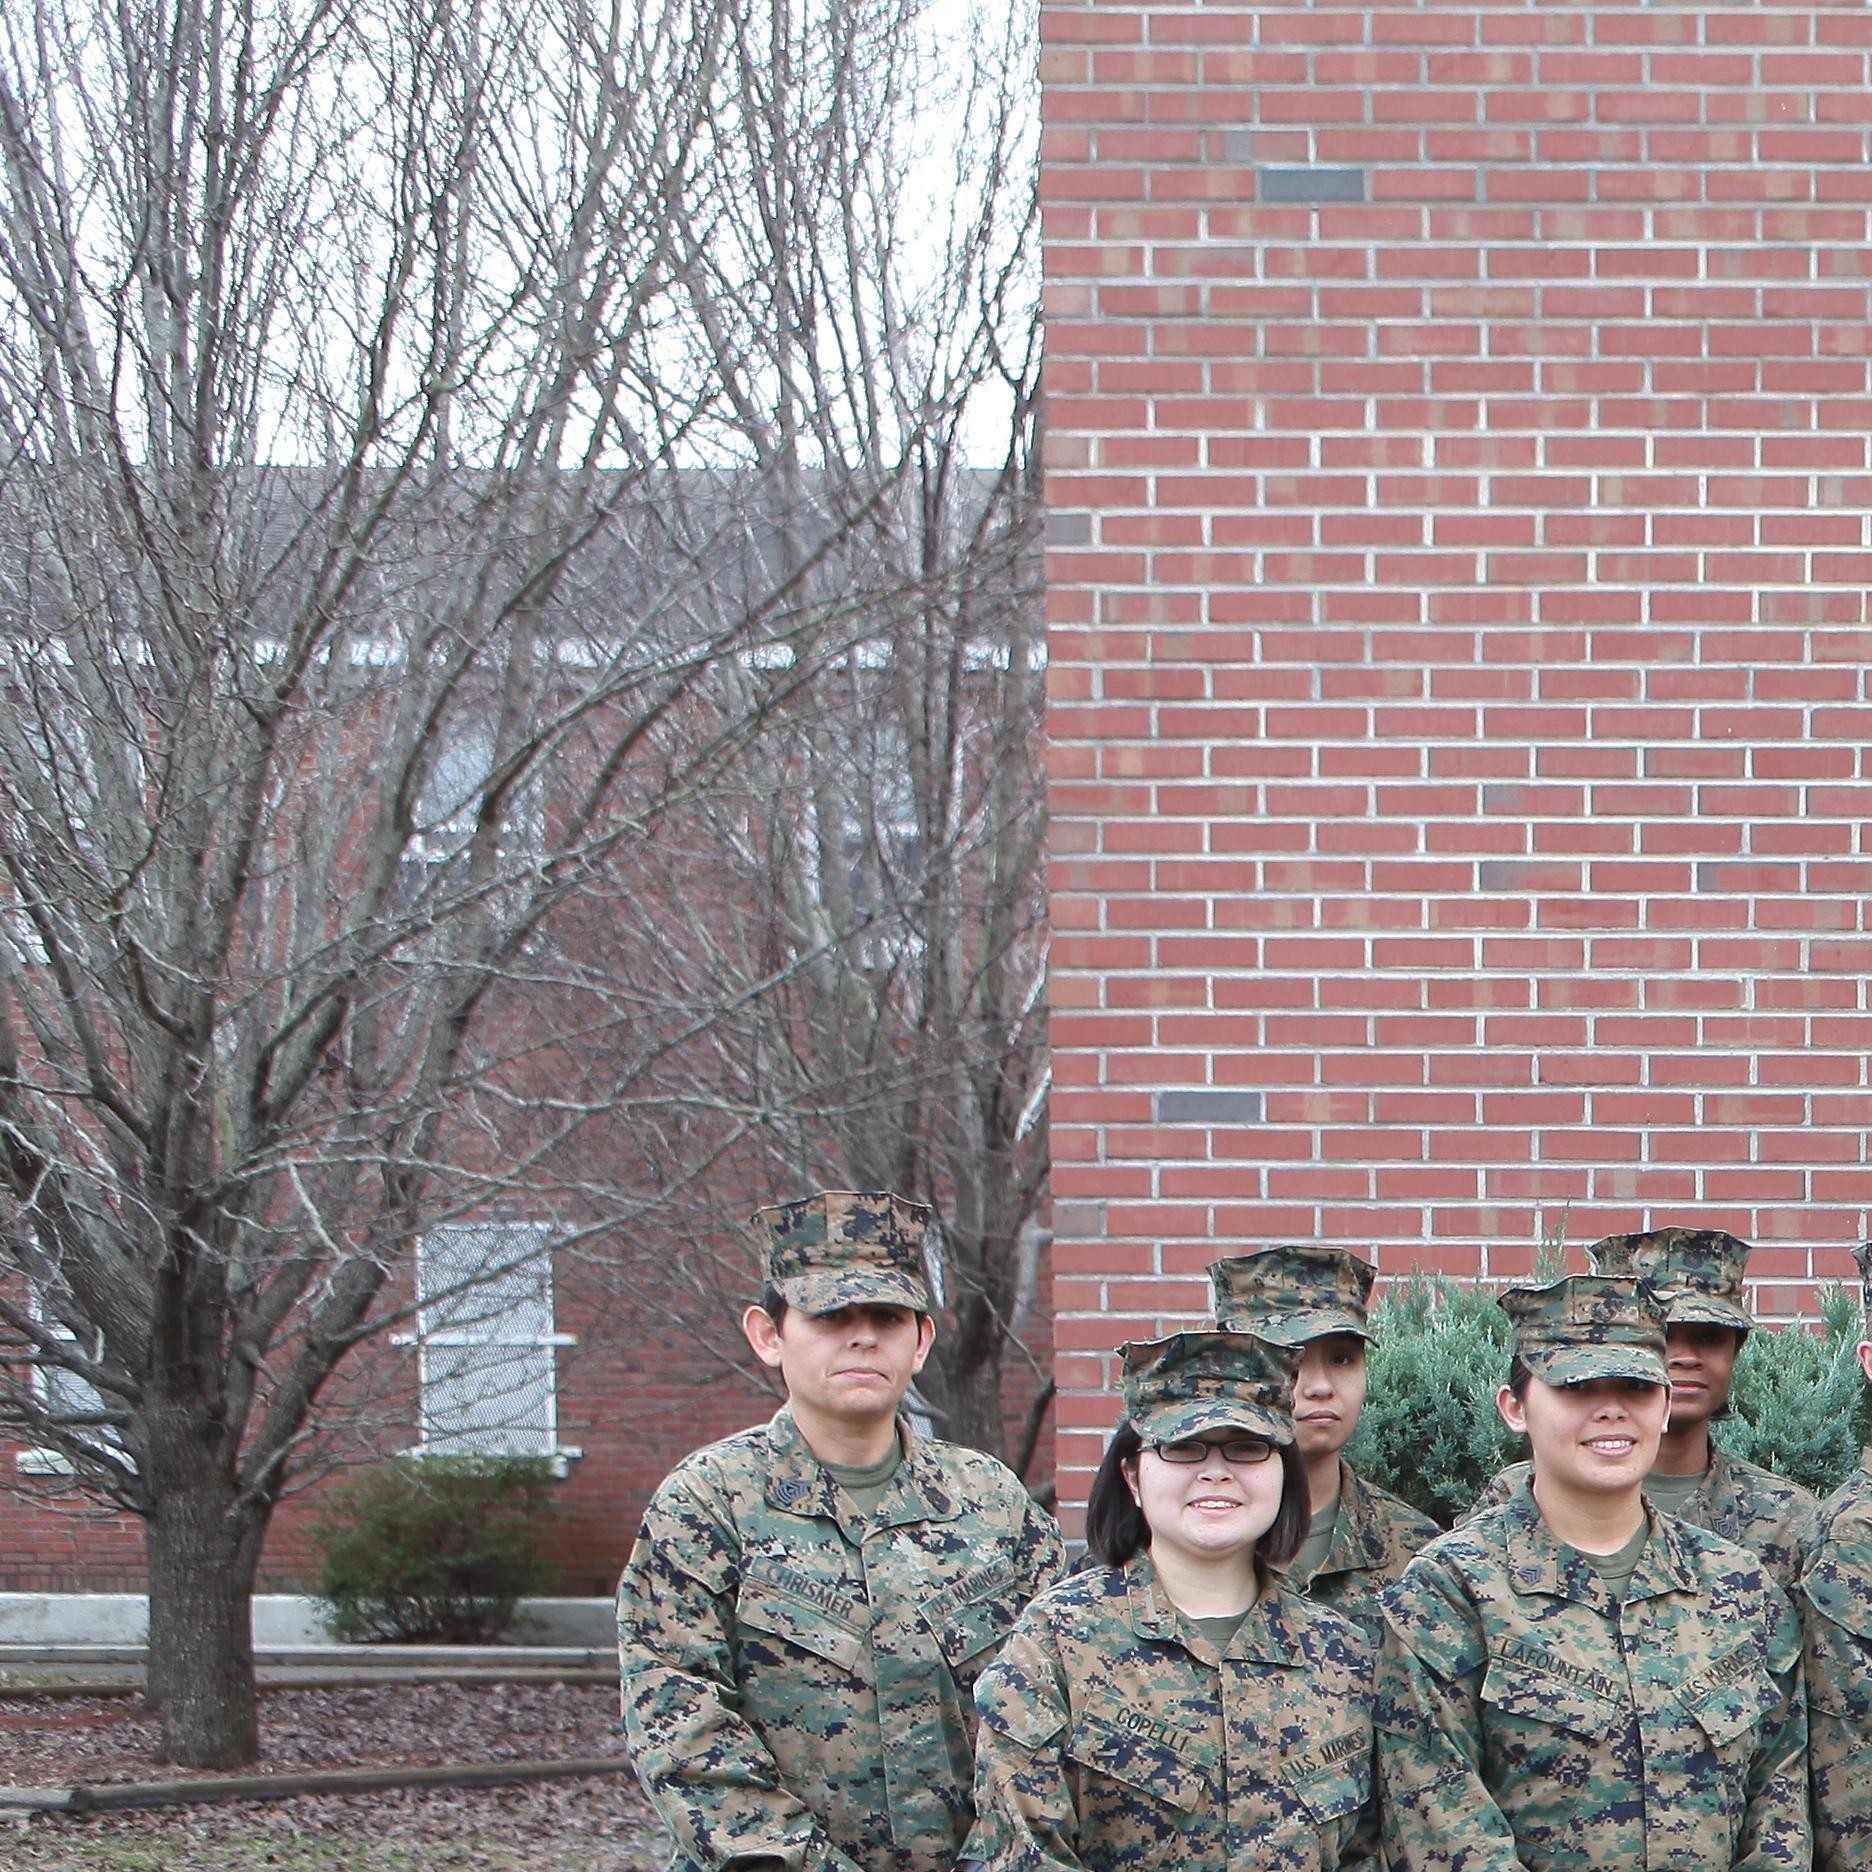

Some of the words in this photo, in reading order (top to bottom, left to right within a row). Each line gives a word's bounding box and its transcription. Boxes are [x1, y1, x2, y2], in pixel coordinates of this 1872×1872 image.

[766, 1566, 854, 1619] CHRISMER
[1499, 1639, 1616, 1696] LAFOUNTAIN
[1116, 1707, 1190, 1753] COPELLI
